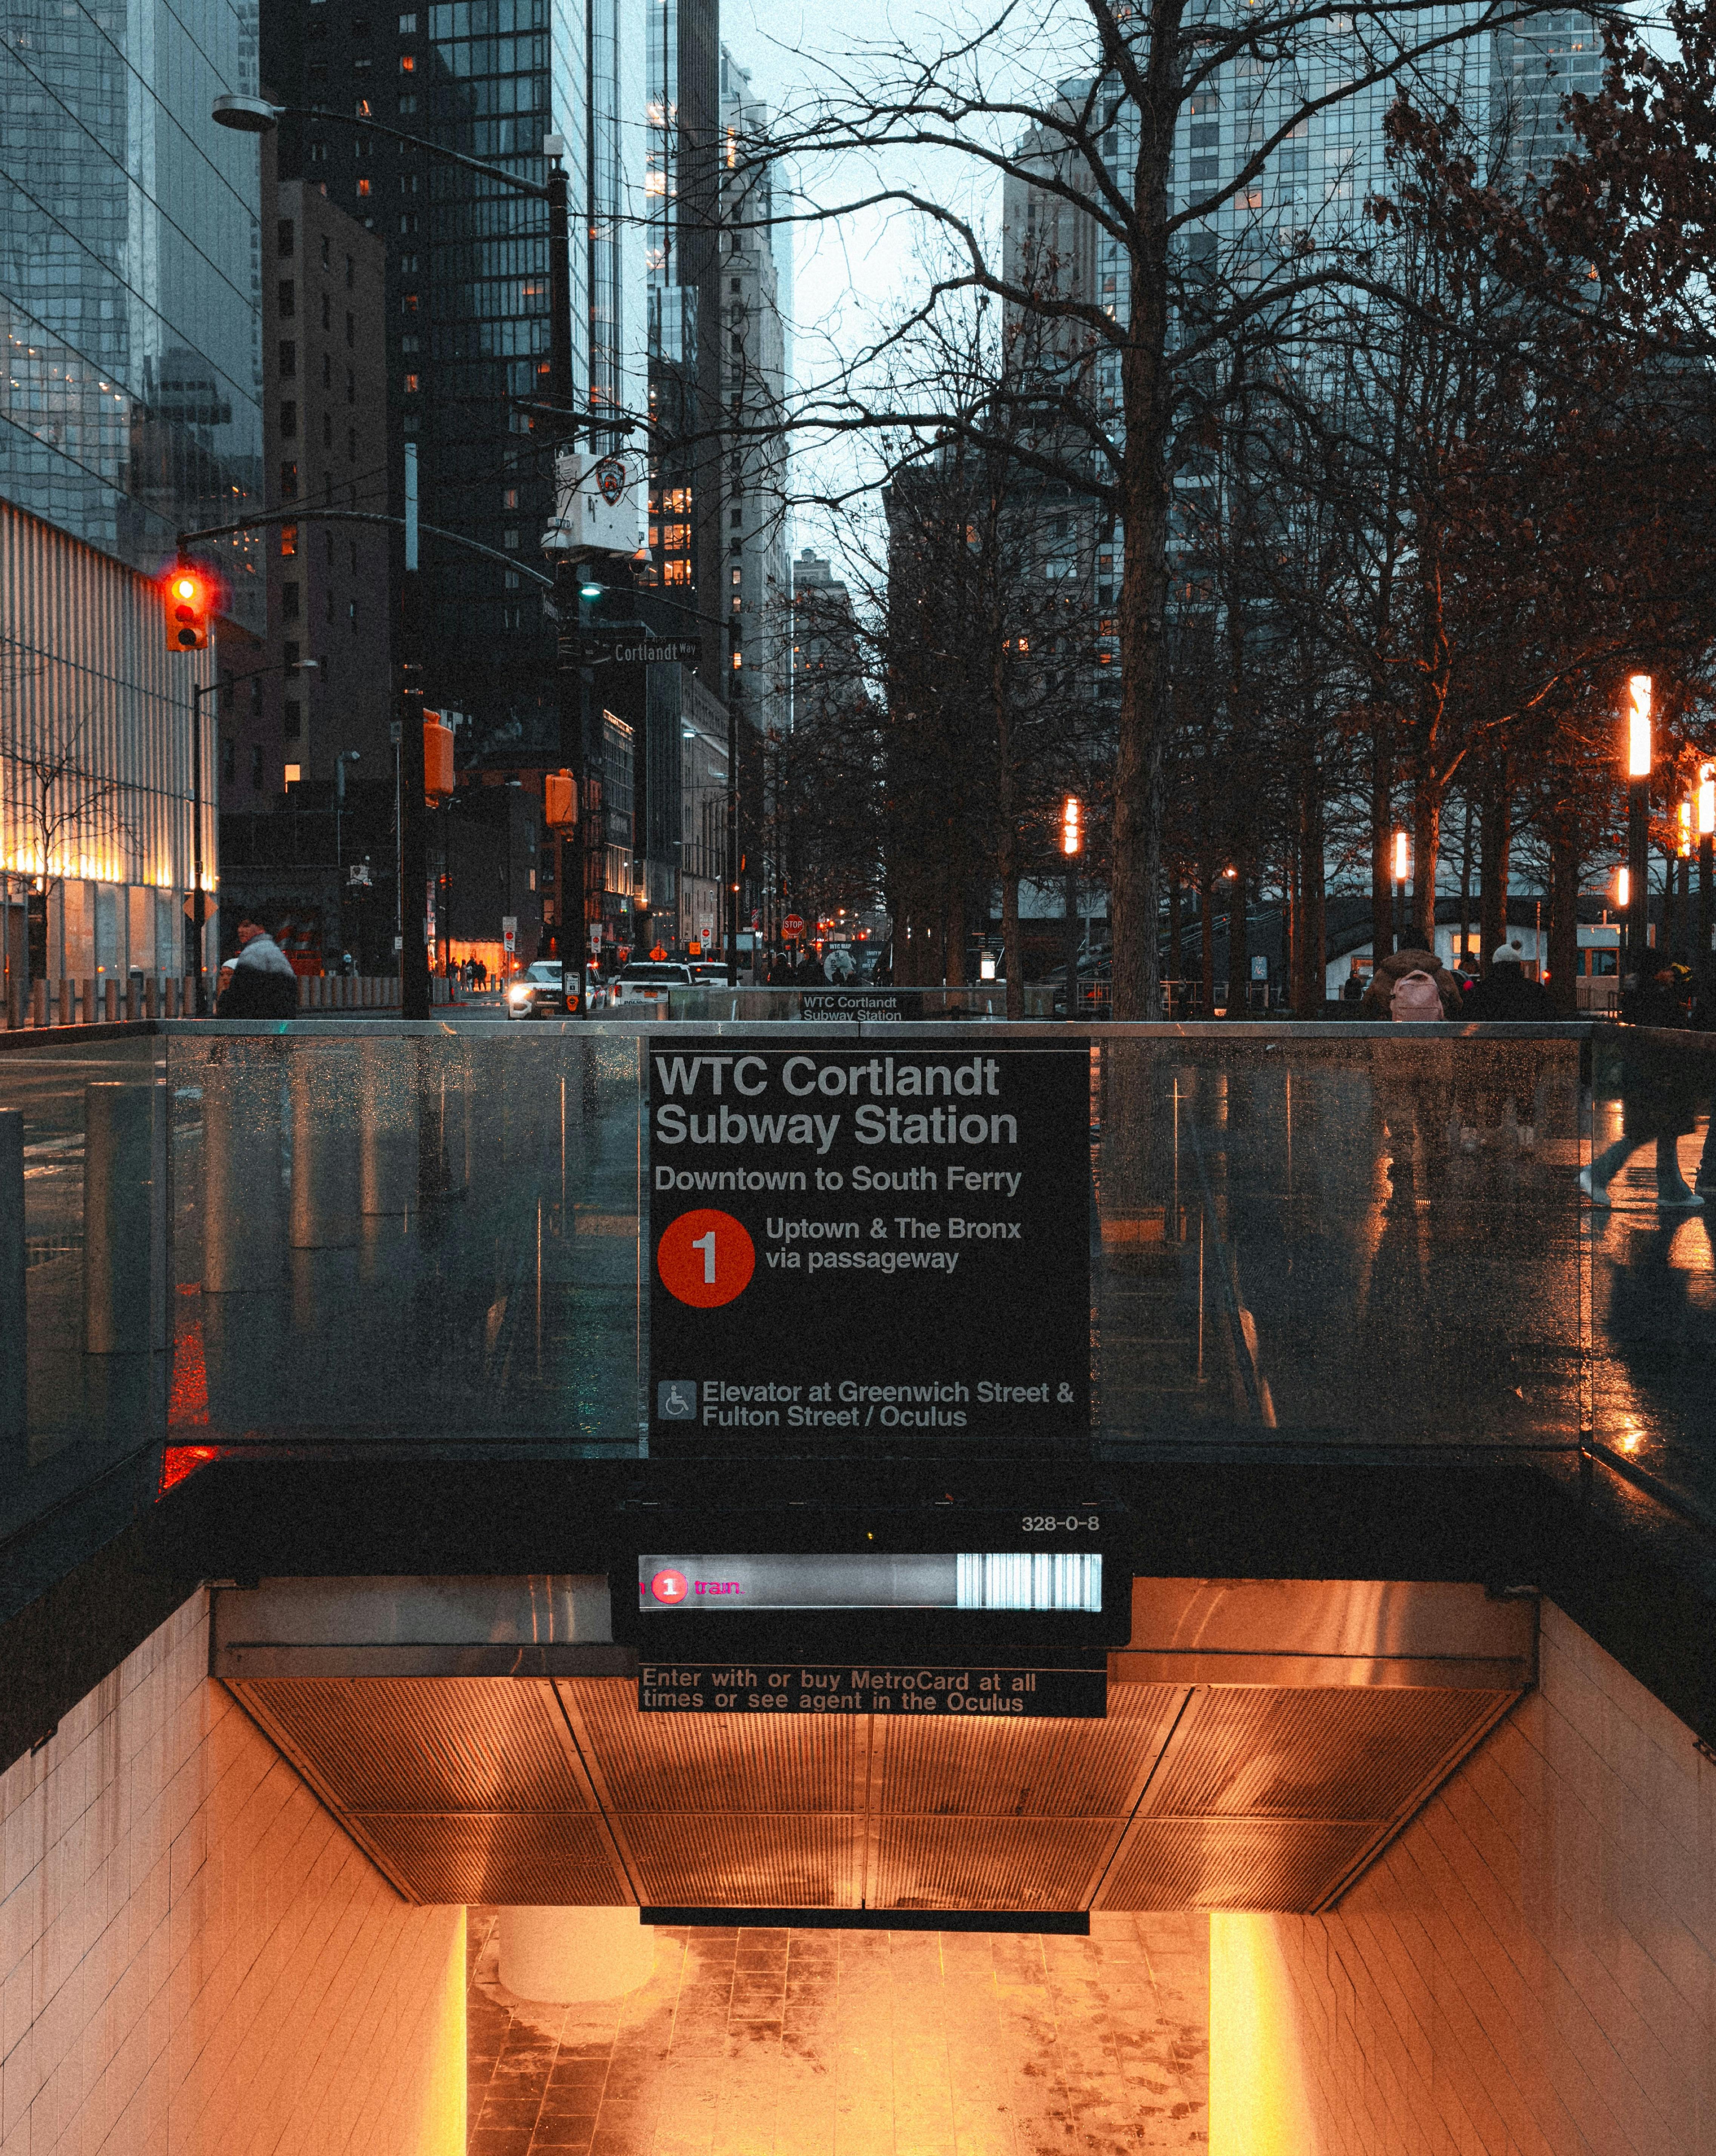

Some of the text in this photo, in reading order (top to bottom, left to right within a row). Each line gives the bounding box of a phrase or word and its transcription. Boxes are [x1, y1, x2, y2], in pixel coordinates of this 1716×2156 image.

[616, 643, 695, 661] Cortlandt Way
[804, 996, 897, 1008] WTC Cortlandt
[804, 1010, 901, 1021] Subway Station
[655, 1056, 1000, 1096] WTC Cortlandt
[656, 1104, 1017, 1154] Subway Station
[655, 1166, 1022, 1197] Downtown to South Ferry
[766, 1218, 1021, 1243] Uptown & The Bronx
[692, 1231, 715, 1283] 1
[766, 1247, 959, 1274] via passageway
[703, 1381, 1074, 1403] Elevator at Greenwich Street &
[703, 1406, 779, 1426] Fulton
[787, 1405, 860, 1426] Street
[880, 1405, 967, 1426] Oculus
[1022, 1516, 1100, 1532] 328-0-8
[663, 1578, 679, 1595] 1
[695, 1580, 746, 1595] train.
[643, 1668, 1036, 1691] Enter with or buy MetroCard at all
[643, 1689, 1024, 1712] times or see agent in the Oculus
